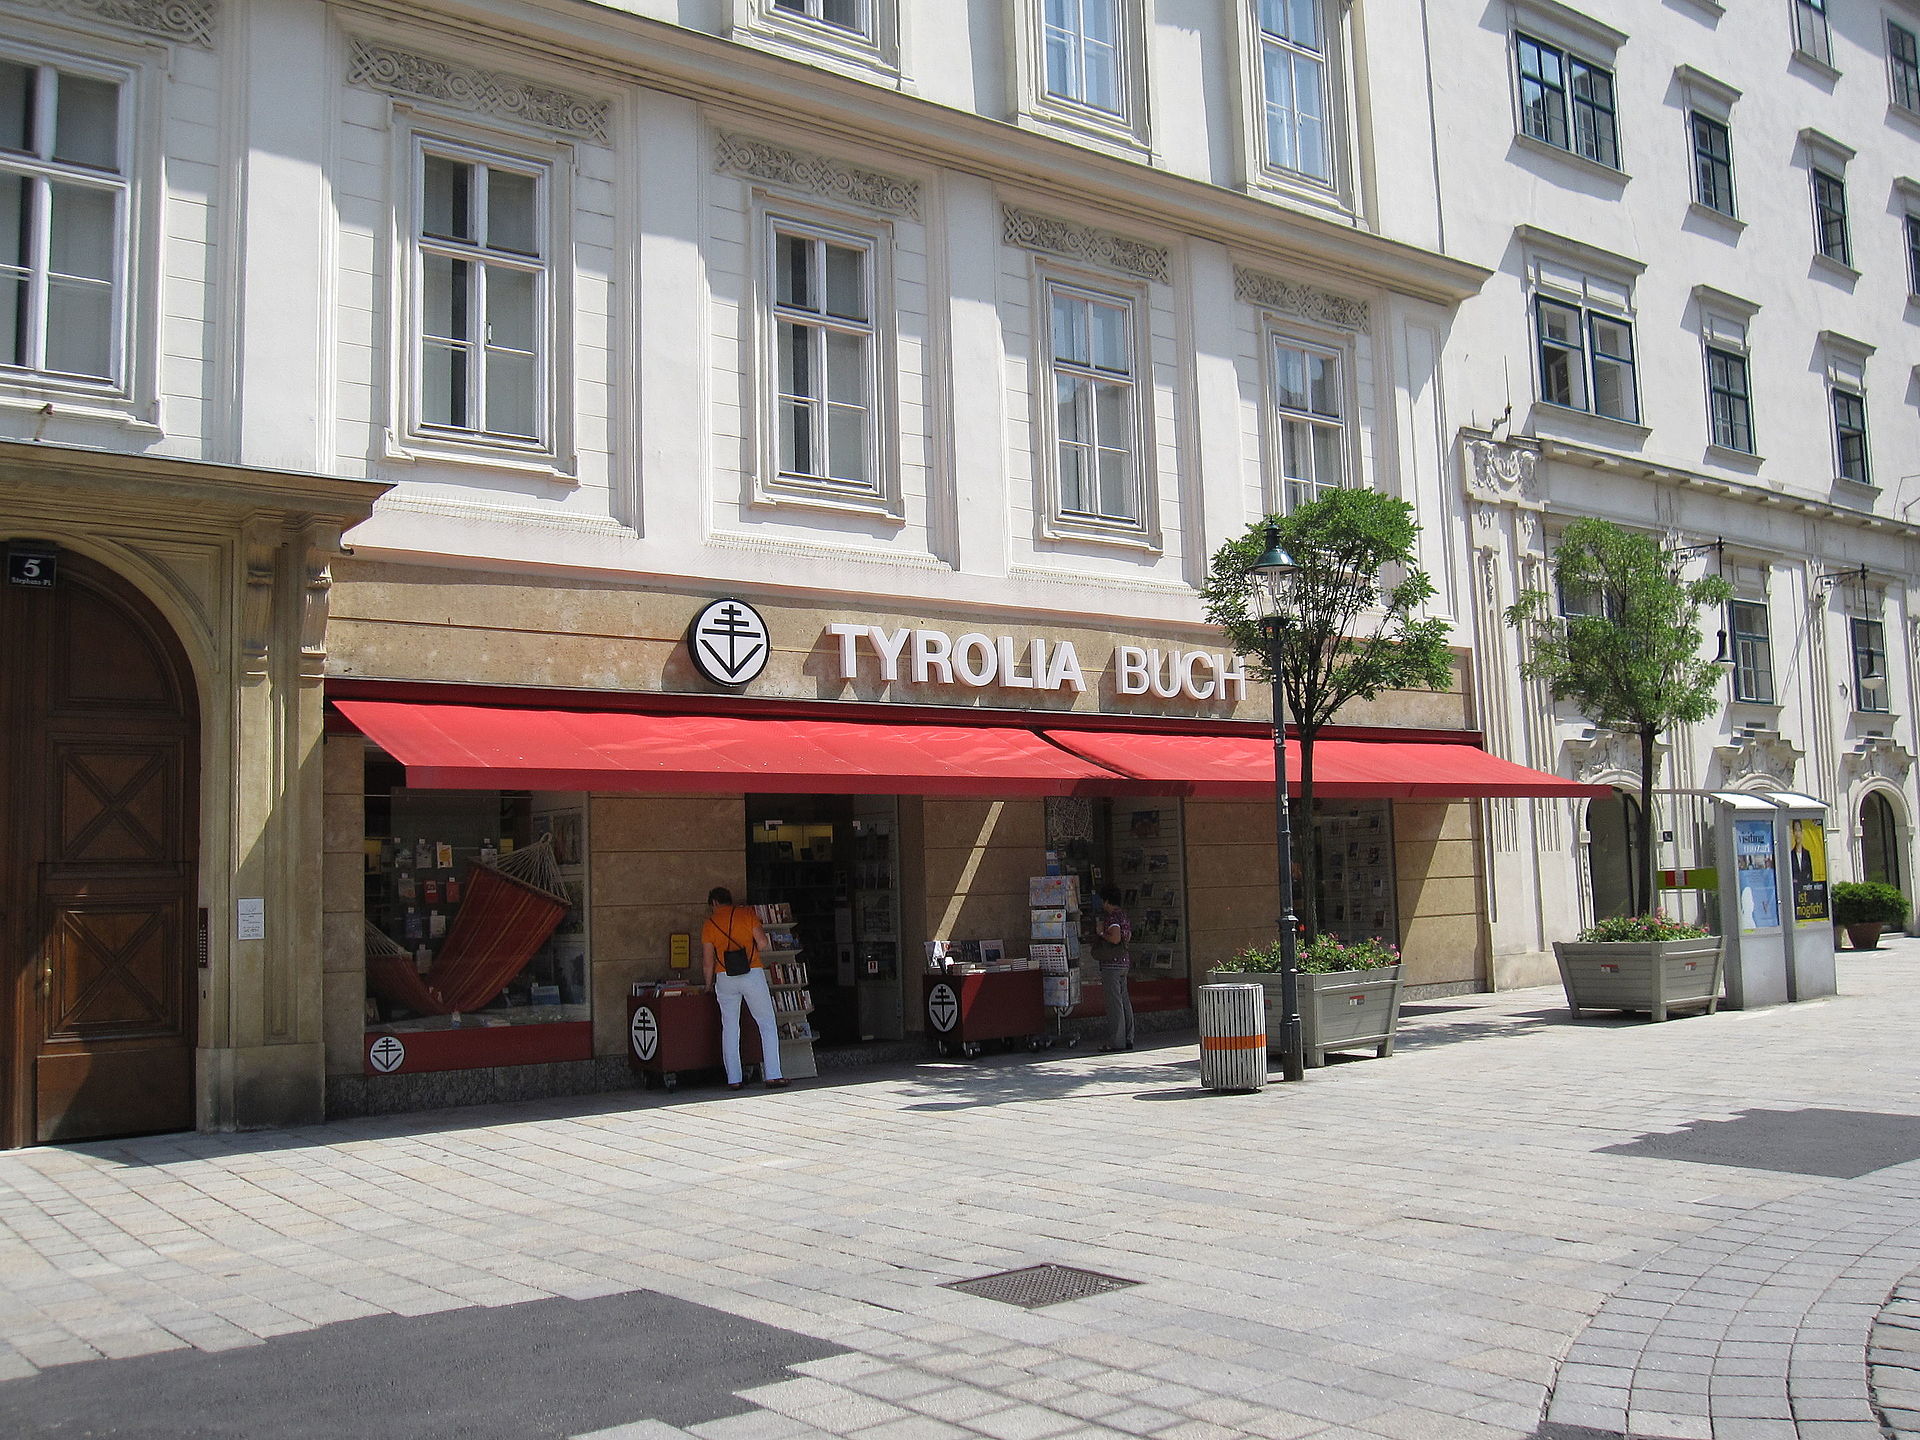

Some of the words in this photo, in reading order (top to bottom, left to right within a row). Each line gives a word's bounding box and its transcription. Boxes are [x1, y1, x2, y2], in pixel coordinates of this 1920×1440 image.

[23, 558, 41, 577] 5
[825, 623, 1087, 693] TYROLIA
[1114, 645, 1247, 701] BUCH
